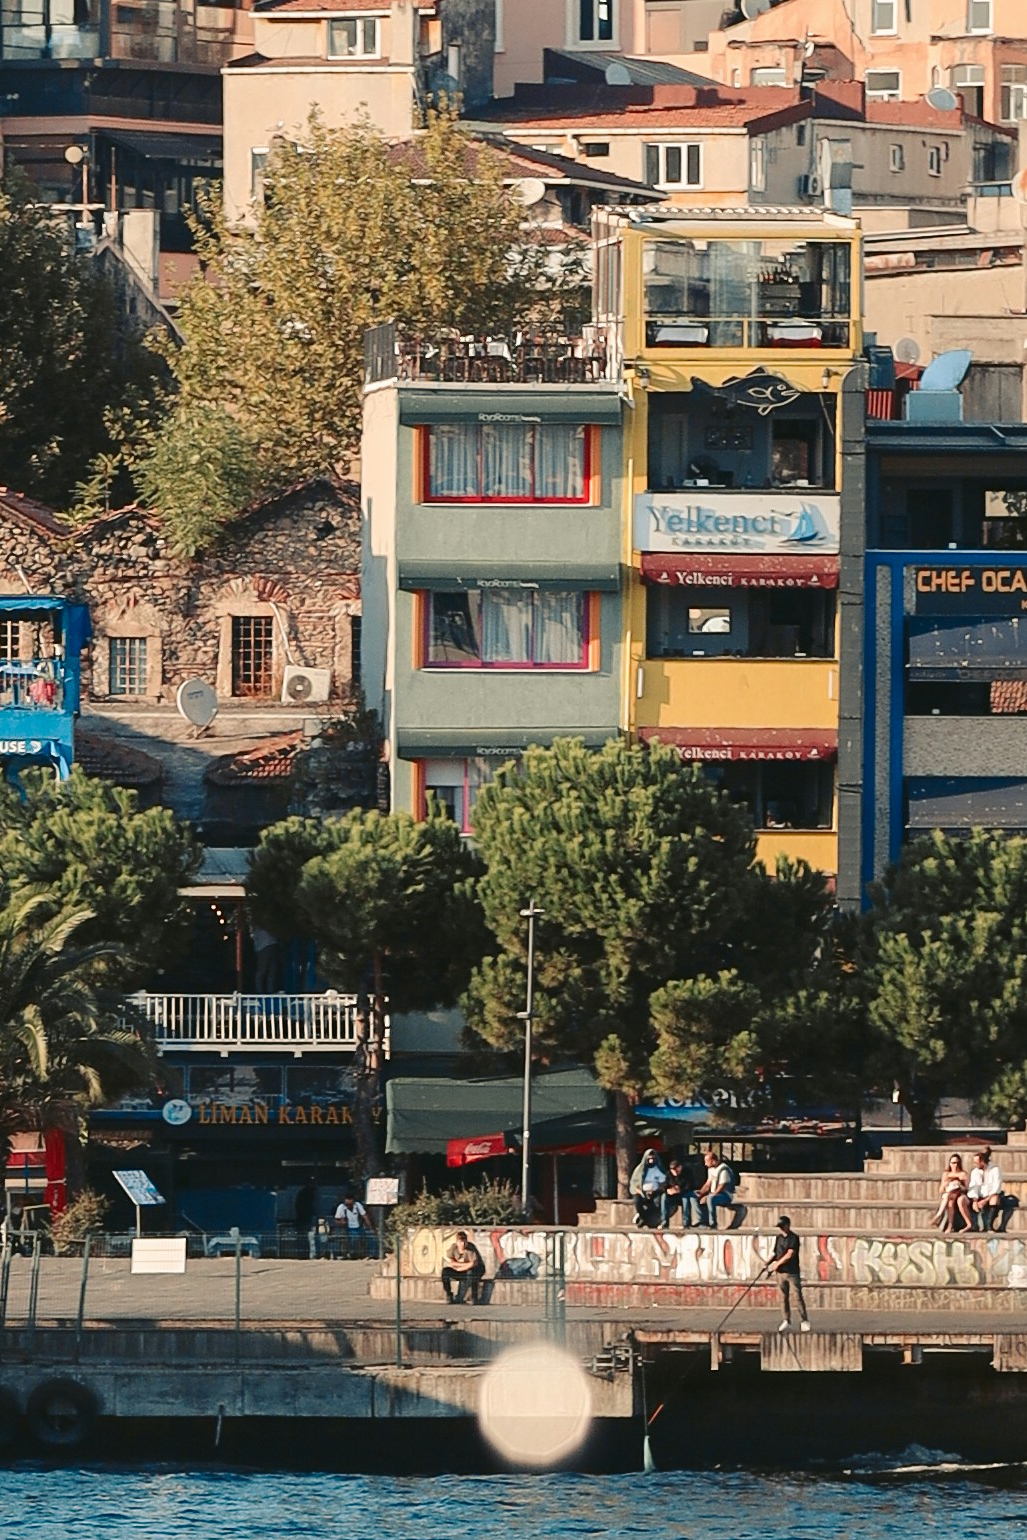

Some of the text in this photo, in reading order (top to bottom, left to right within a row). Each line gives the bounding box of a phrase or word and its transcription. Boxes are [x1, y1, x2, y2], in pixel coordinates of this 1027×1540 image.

[647, 504, 780, 534] Yelkenci
[676, 571, 733, 586] Yelkenci
[917, 570, 975, 593] CHEF
